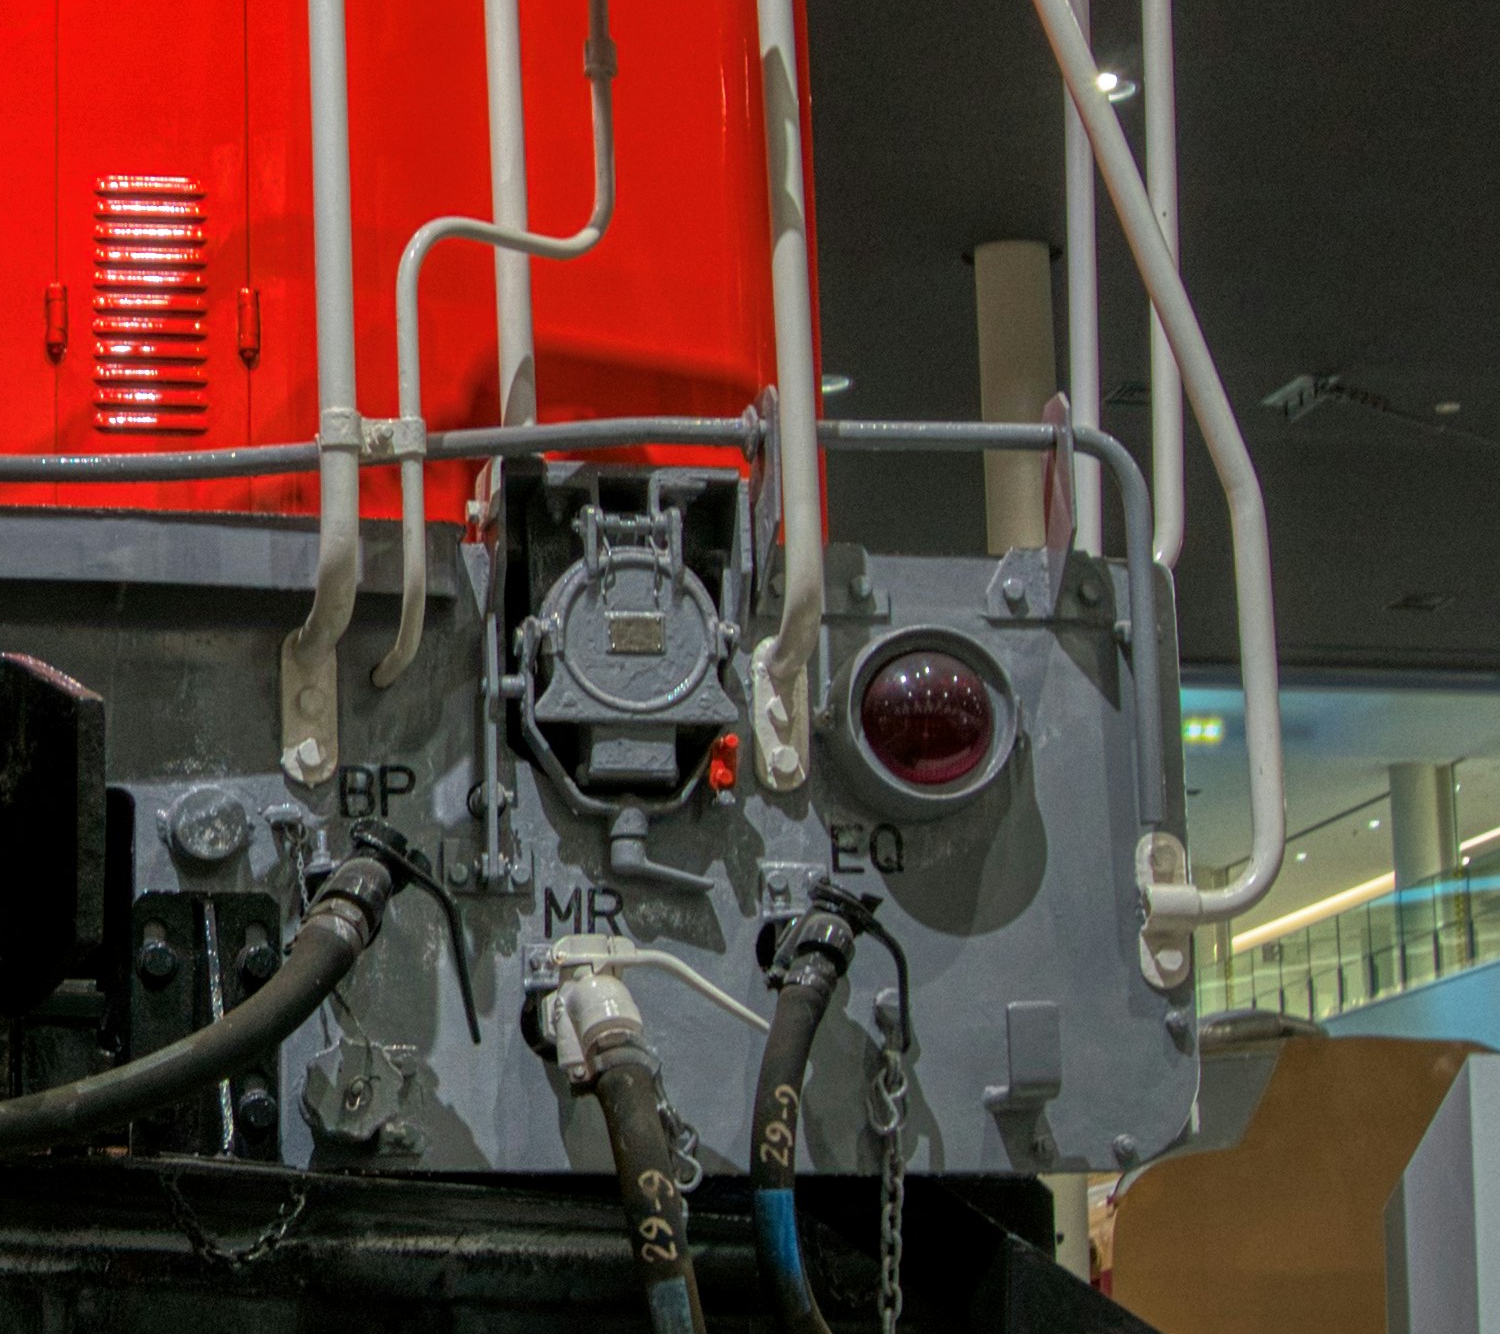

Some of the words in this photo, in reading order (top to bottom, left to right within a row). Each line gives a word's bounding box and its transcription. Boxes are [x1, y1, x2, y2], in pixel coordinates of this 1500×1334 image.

[339, 764, 416, 817] BP
[830, 823, 904, 873] EQ
[543, 886, 624, 939] MR
